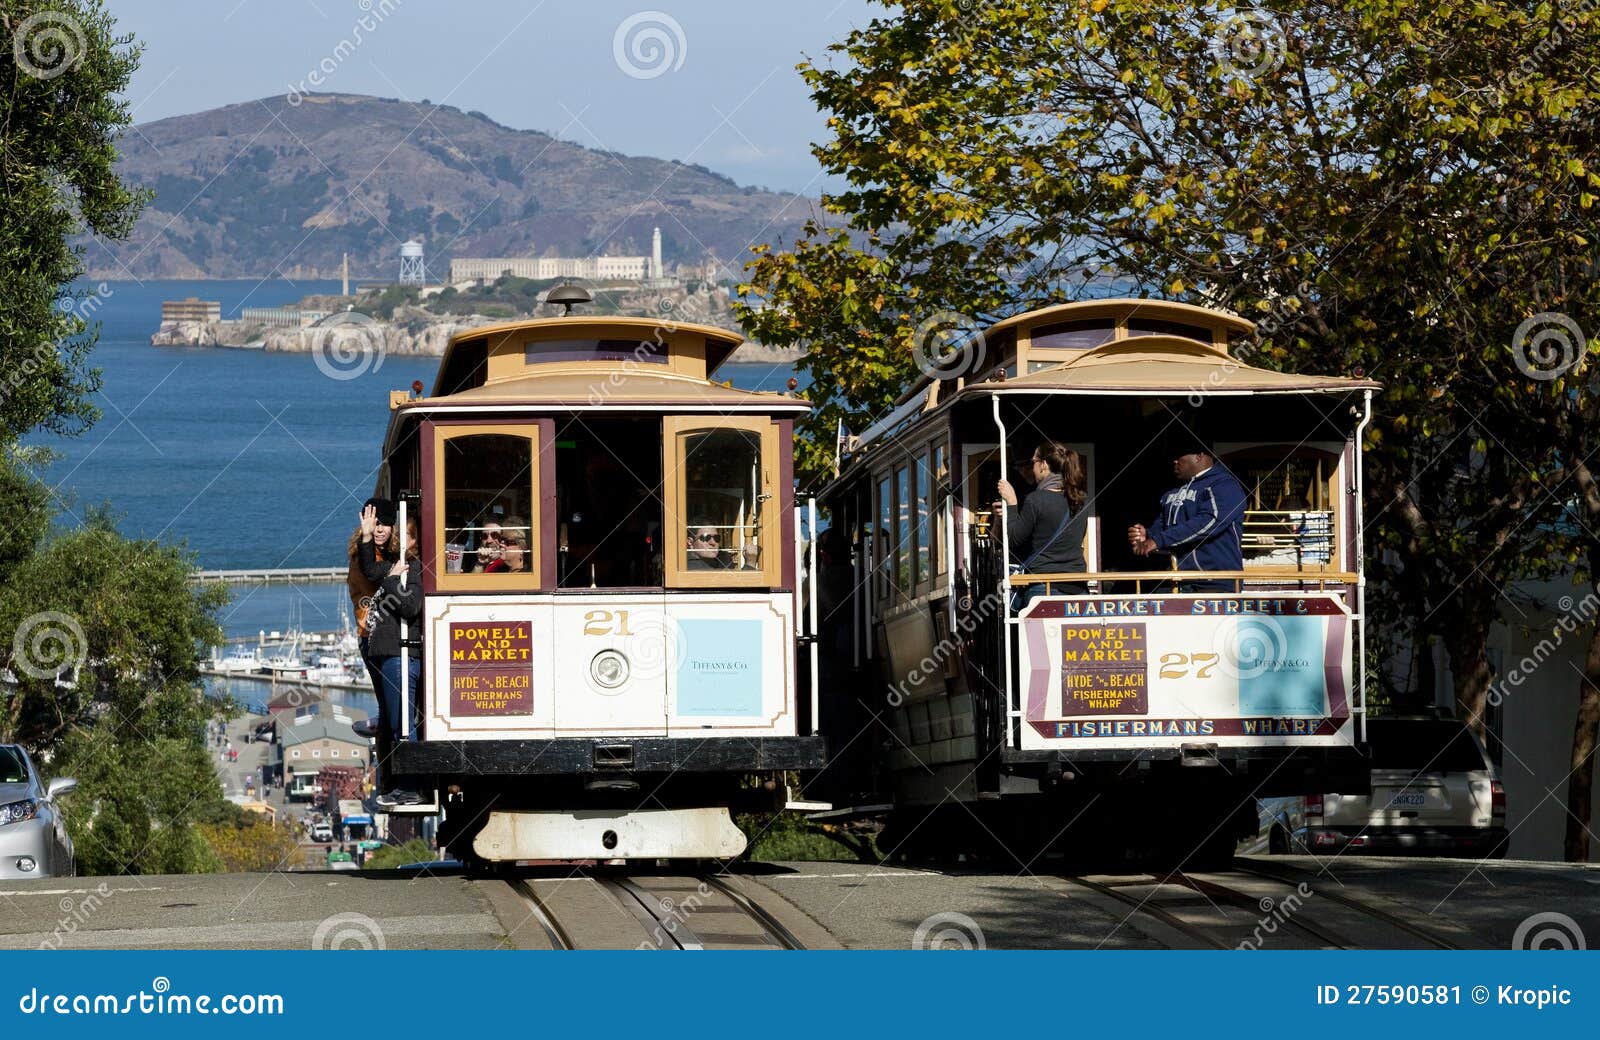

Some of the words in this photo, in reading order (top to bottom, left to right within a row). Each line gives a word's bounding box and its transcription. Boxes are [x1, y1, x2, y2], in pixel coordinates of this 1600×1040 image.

[1064, 600, 1164, 617] MARKET
[1192, 599, 1286, 616] STREET
[583, 609, 634, 636] 21
[454, 628, 528, 640] POWELL
[1066, 628, 1142, 640] POWELL
[474, 640, 511, 649] AND
[1087, 640, 1124, 649] AND
[453, 649, 530, 660] MARKET
[1065, 650, 1144, 661] MARKET
[1159, 652, 1220, 679] 27
[453, 676, 479, 689] HYDE
[495, 675, 529, 688] BEACH
[1066, 674, 1093, 688] HYDE
[1110, 673, 1144, 687] BEACH
[460, 691, 523, 700] FISHERMANS
[1073, 690, 1137, 699] FISHERMANS
[475, 700, 508, 709] WHARF
[1088, 699, 1122, 709] WHARF
[1055, 720, 1214, 737] FISHERMANS
[1242, 719, 1321, 736] WHARF
